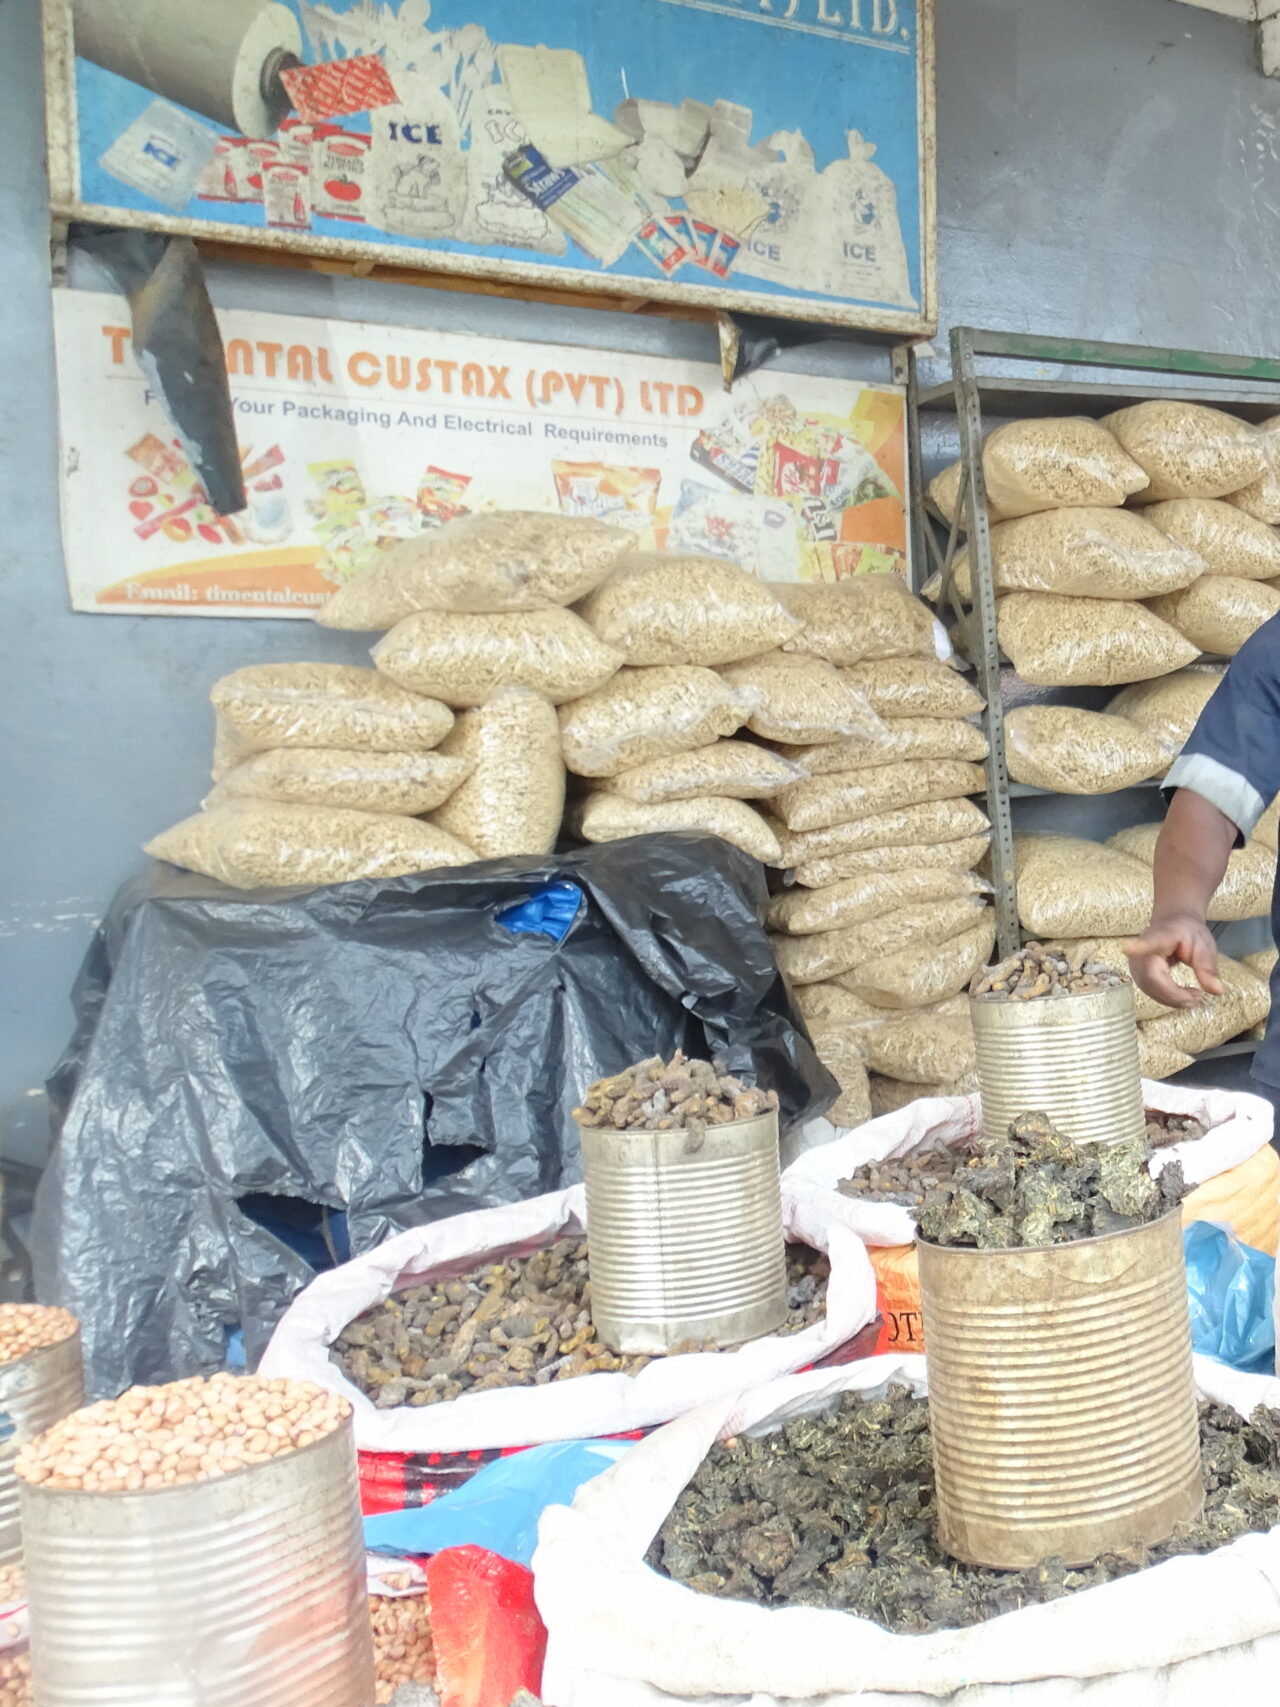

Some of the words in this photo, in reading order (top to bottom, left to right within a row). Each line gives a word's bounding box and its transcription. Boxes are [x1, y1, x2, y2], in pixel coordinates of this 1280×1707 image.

[387, 121, 443, 145] ICE
[842, 240, 878, 262] ICE
[347, 350, 512, 400] CUSTAX
[524, 368, 625, 416] (PVT)
[639, 379, 705, 417] LTD
[282, 400, 392, 428] Packaging
[397, 410, 438, 429] And
[443, 414, 533, 437] Electrical
[543, 422, 669, 449] Requirements
